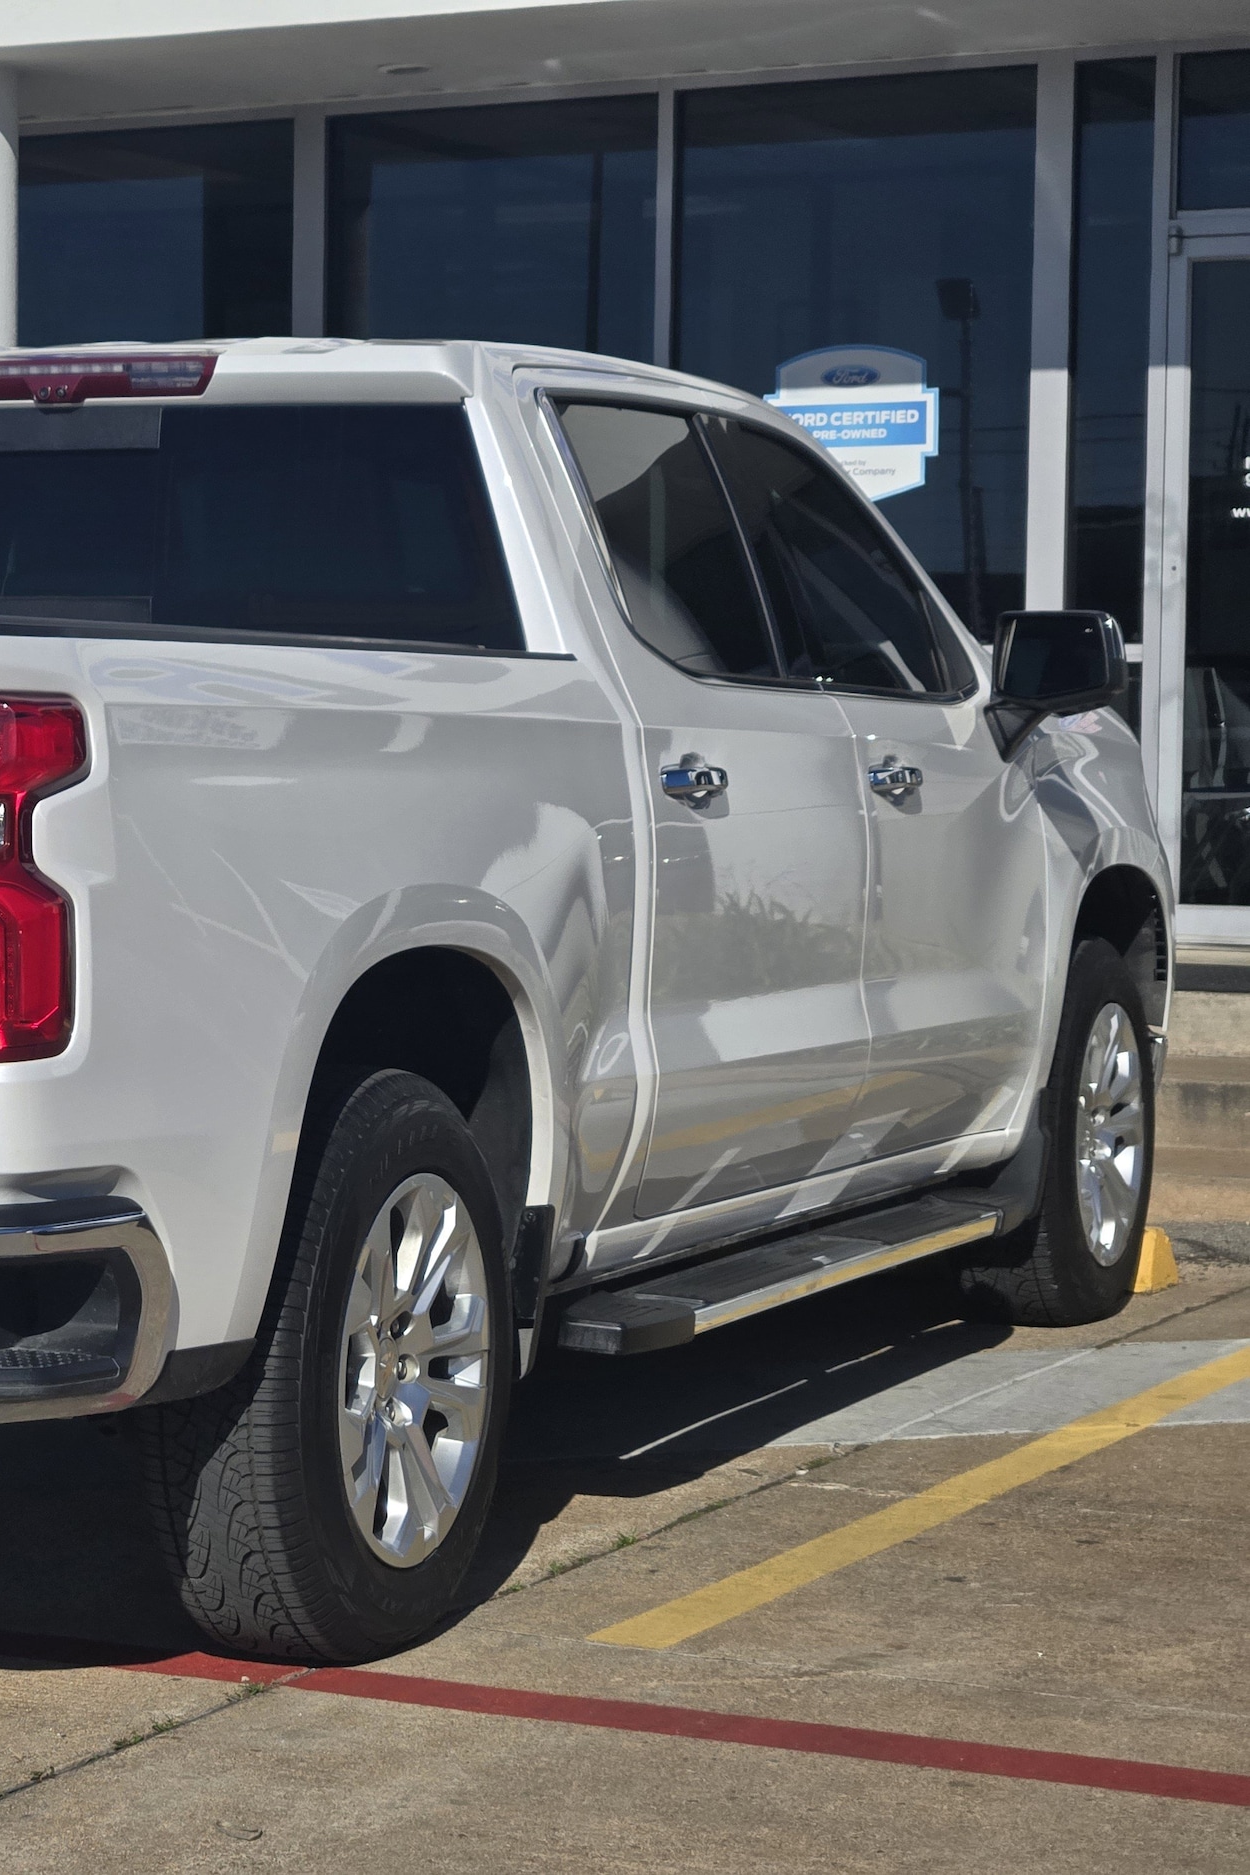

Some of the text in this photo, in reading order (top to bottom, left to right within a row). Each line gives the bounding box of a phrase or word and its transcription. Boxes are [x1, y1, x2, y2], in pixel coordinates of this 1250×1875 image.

[832, 368, 868, 384] Ford
[788, 409, 920, 427] ORD CERTIFIED
[812, 428, 888, 440] PRE-OWNED
[852, 467, 896, 476] Company
